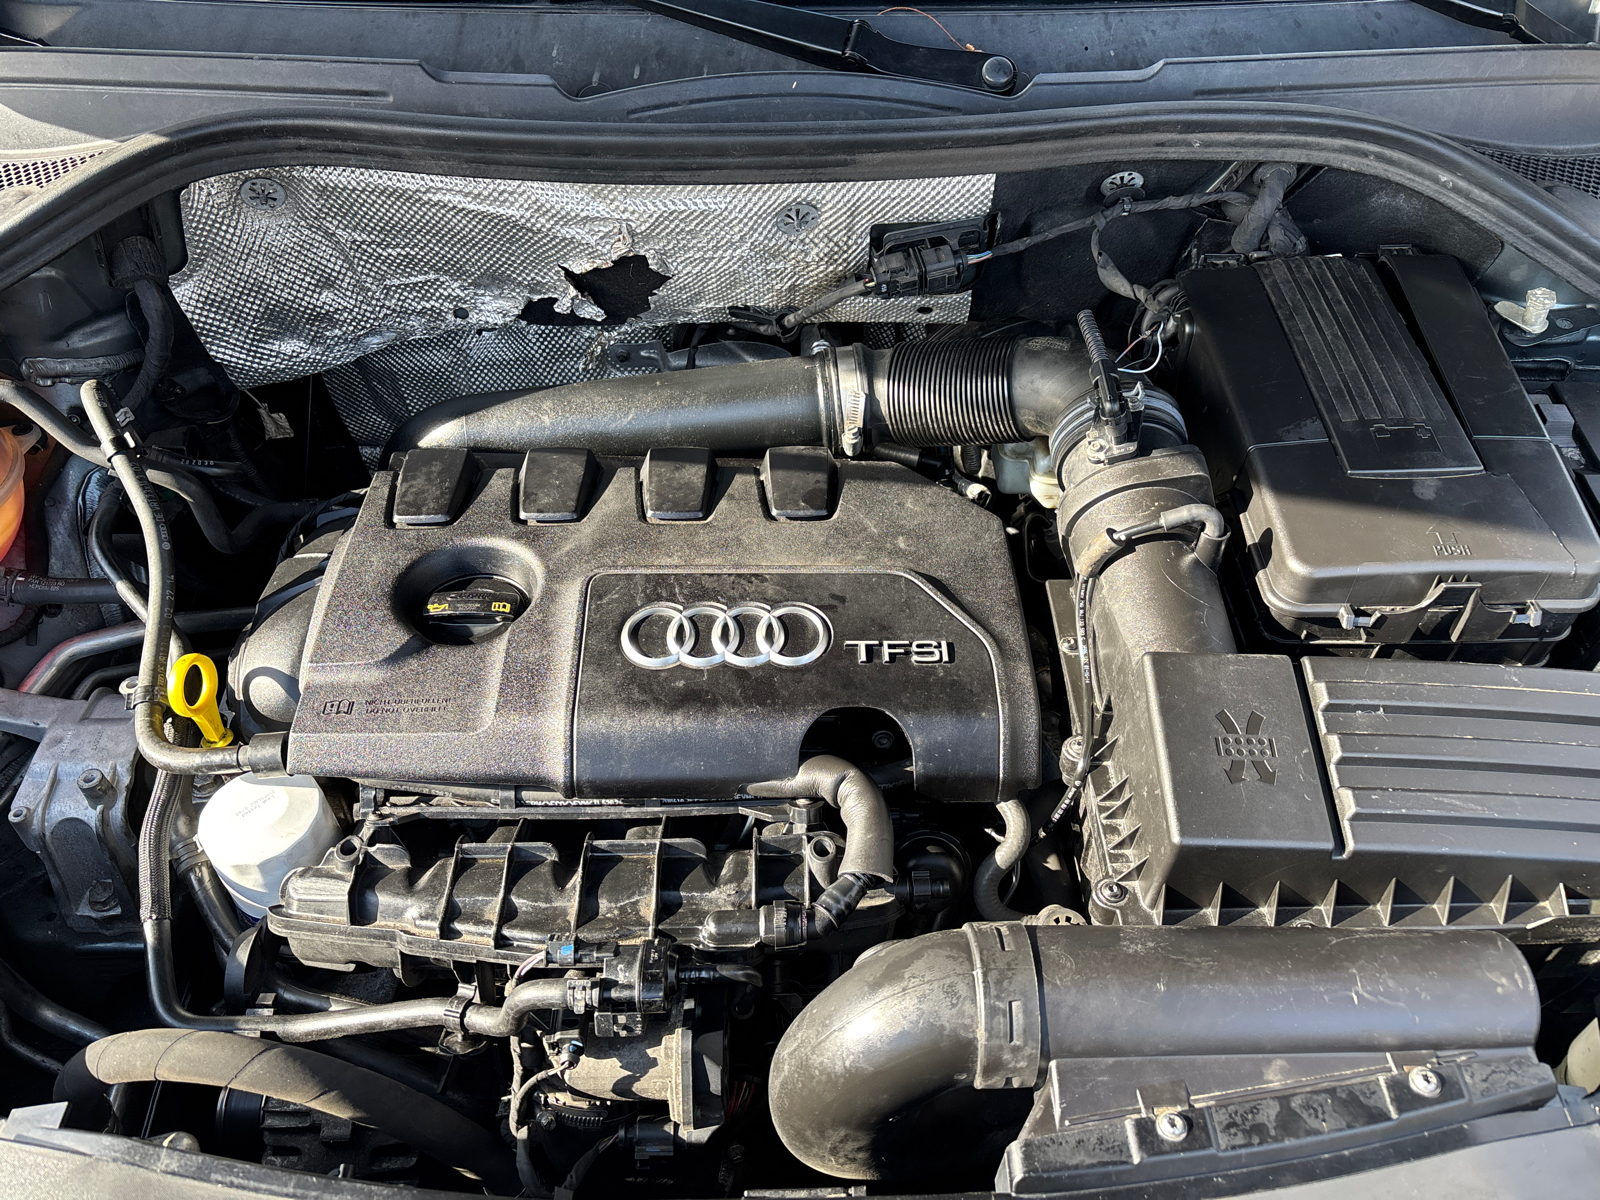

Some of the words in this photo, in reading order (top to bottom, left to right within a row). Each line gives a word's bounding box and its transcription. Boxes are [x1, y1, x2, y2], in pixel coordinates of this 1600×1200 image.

[1432, 544, 1473, 557] PUSH
[165, 573, 174, 584] 14
[165, 589, 175, 601] 27
[164, 607, 173, 618] 02
[843, 640, 955, 665] TFSI
